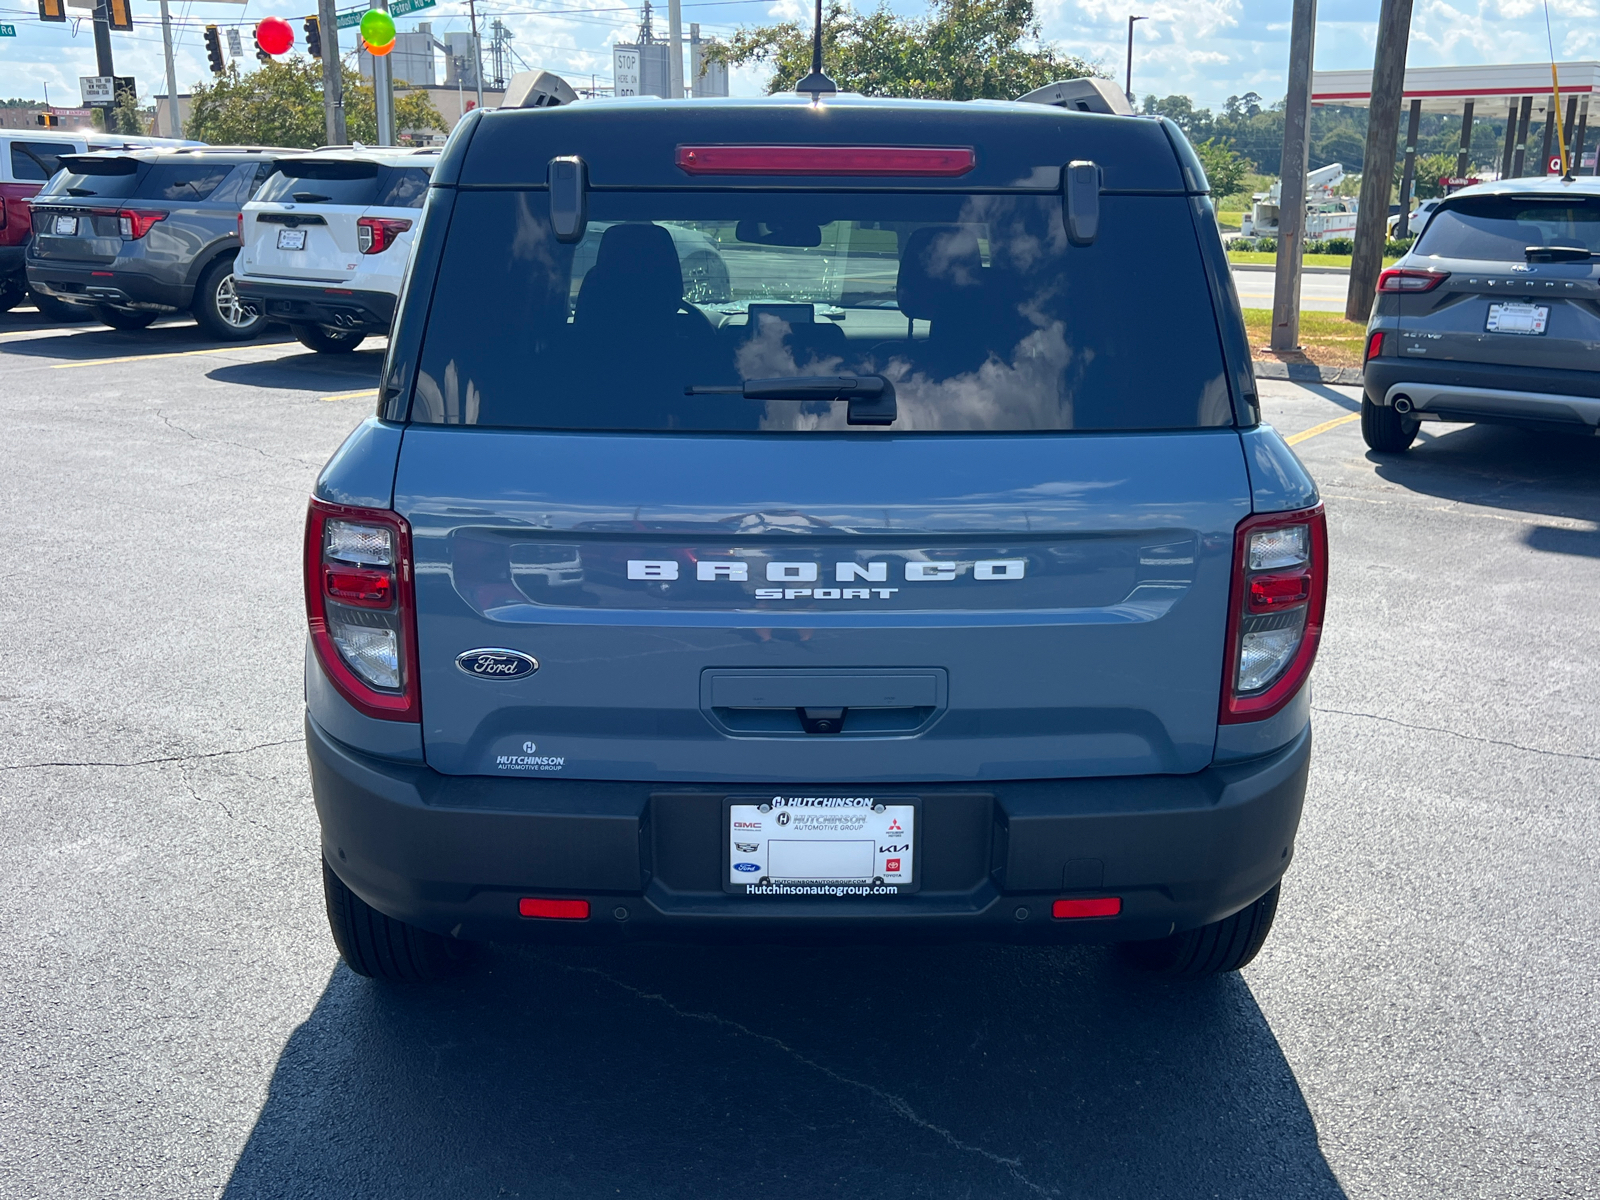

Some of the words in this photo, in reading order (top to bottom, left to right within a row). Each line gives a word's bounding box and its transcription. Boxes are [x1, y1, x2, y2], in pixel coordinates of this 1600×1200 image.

[390, 1, 412, 15] Patrol
[1, 25, 13, 35] Rd
[618, 55, 636, 69] STOP
[617, 74, 629, 84] HERE
[630, 75, 638, 84] ON
[627, 560, 1025, 583] BRONCO
[755, 588, 899, 600] SPORT
[473, 654, 518, 675] Ford
[496, 755, 565, 766] HUTCHINSON
[787, 797, 874, 809] HUTCHINSON
[792, 814, 867, 825] HUTCHINSON
[746, 884, 898, 897] Hutchinsonautogroup.com
